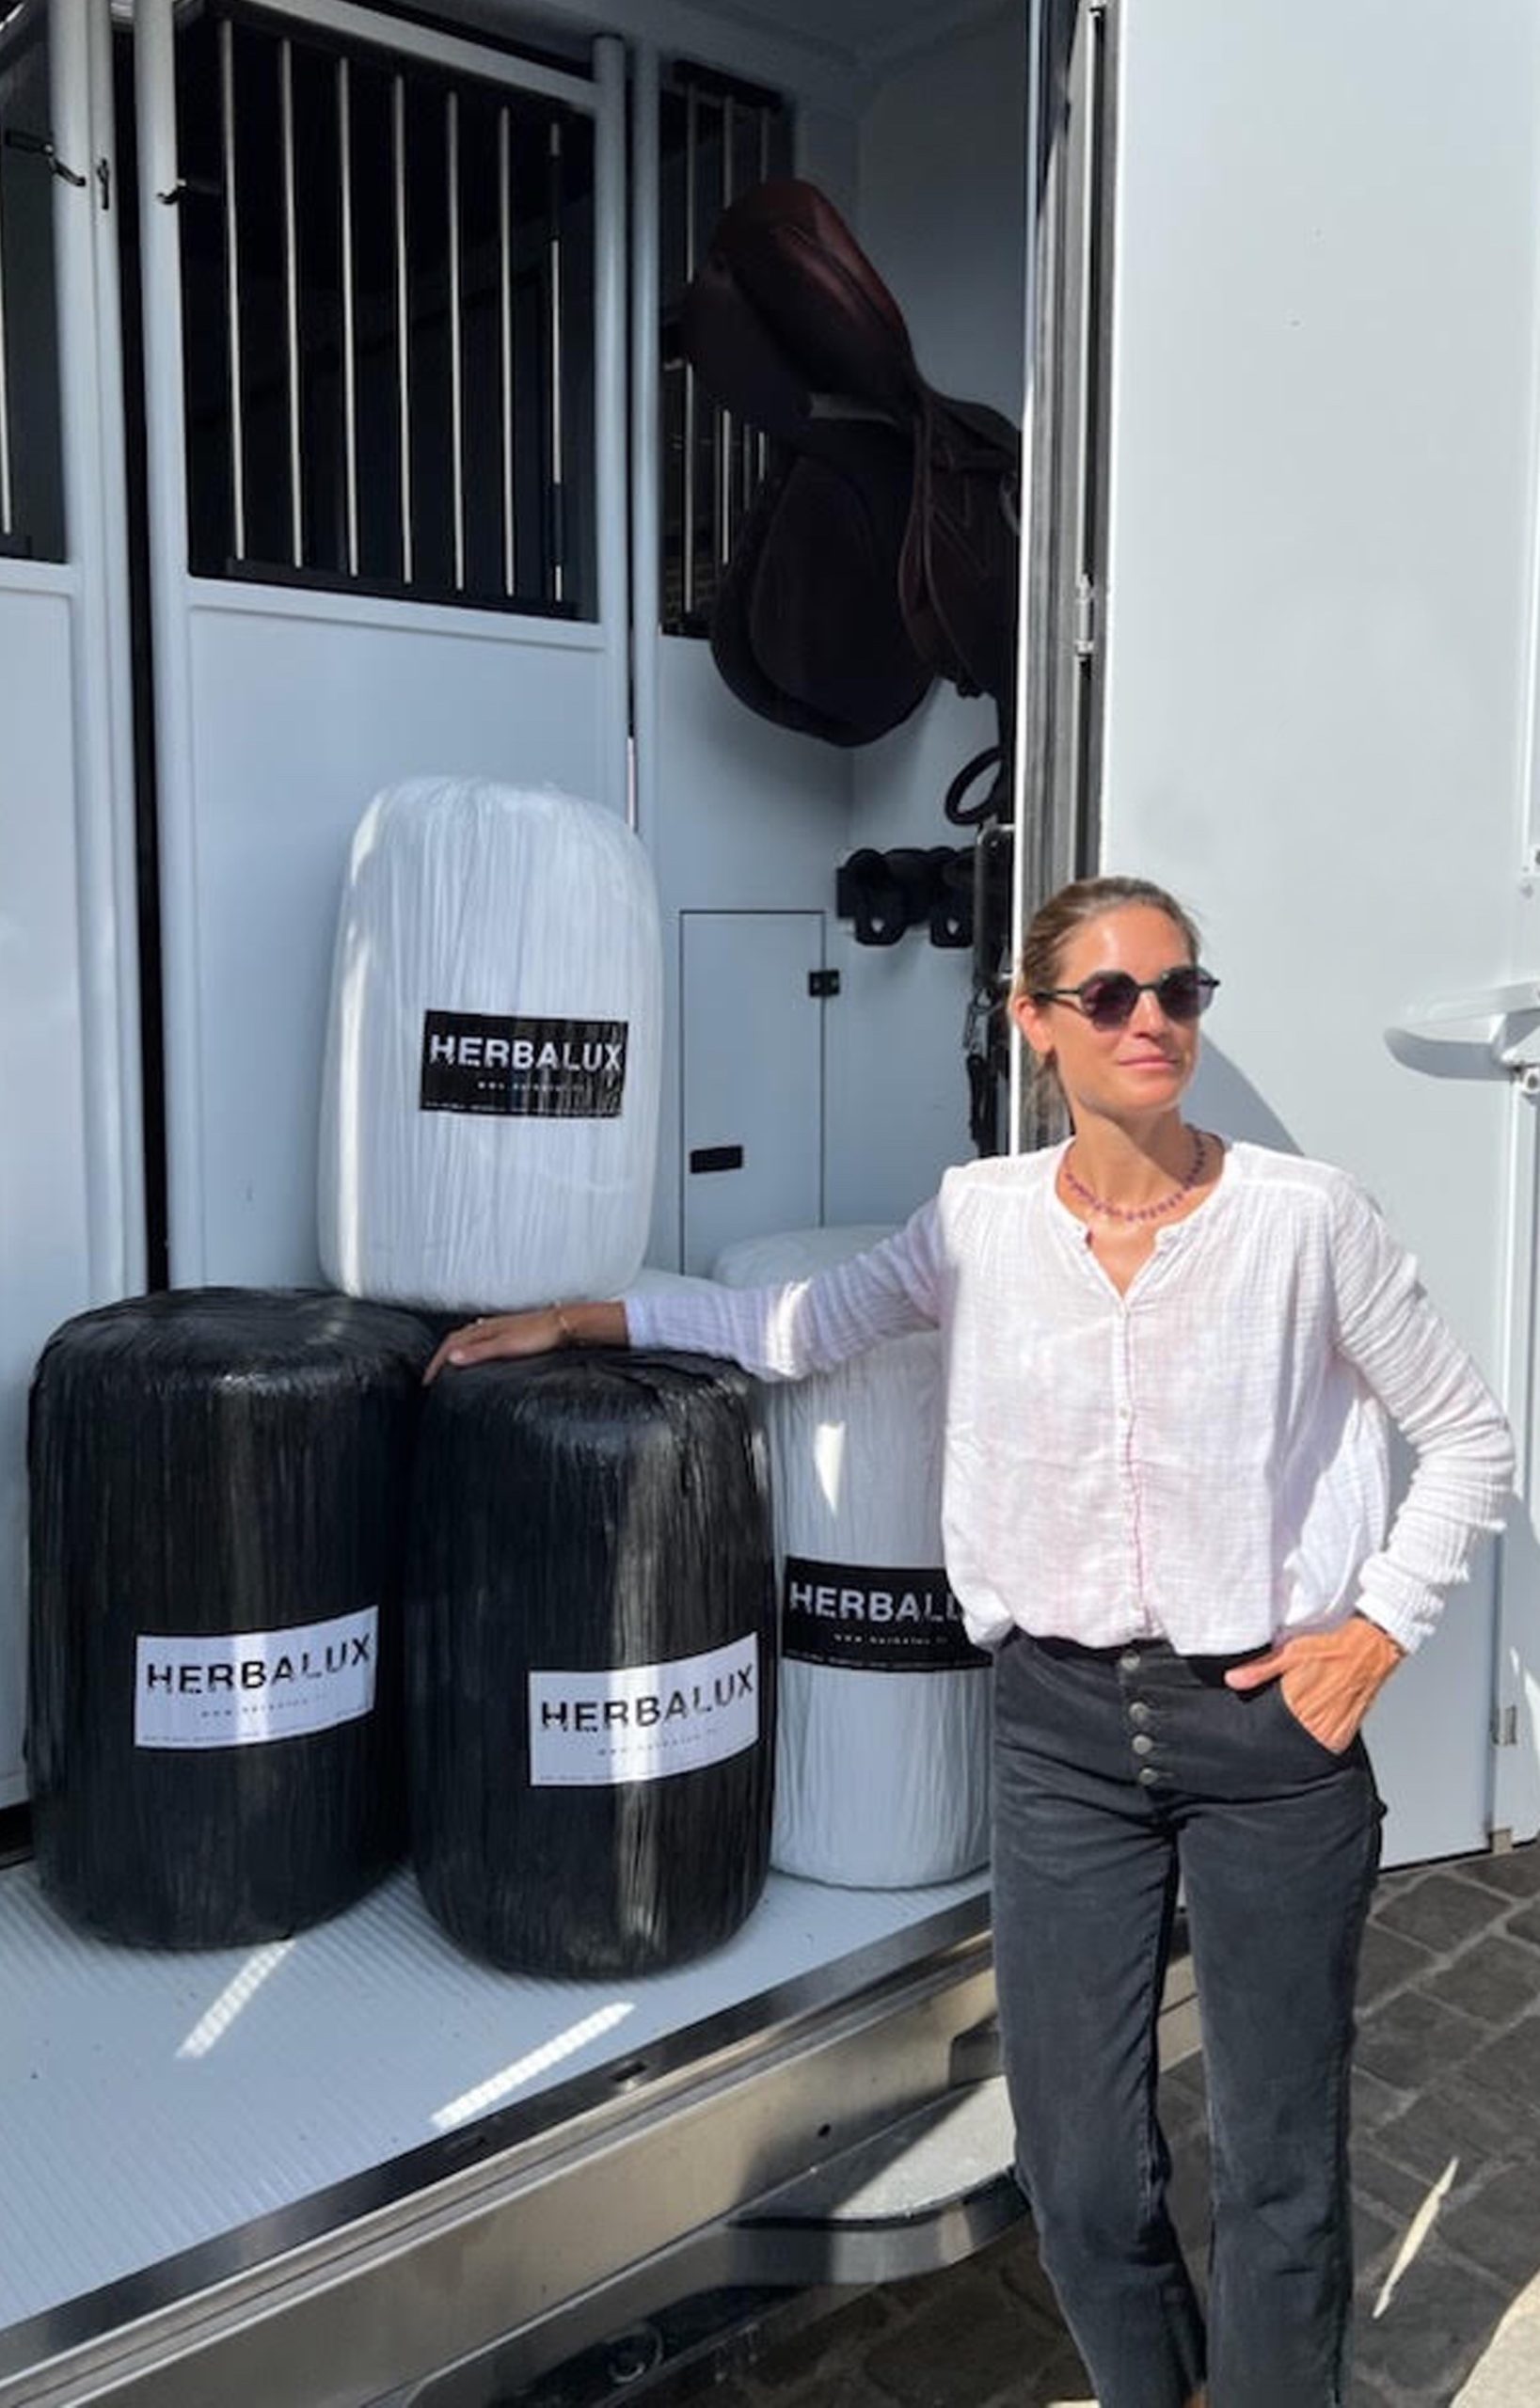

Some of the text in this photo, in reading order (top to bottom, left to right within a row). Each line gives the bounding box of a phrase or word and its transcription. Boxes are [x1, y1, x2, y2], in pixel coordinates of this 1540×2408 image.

[429, 1035, 623, 1071] HERBALUX
[147, 1633, 371, 1694] HERBALUX
[541, 1663, 754, 1733] HERBALUX
